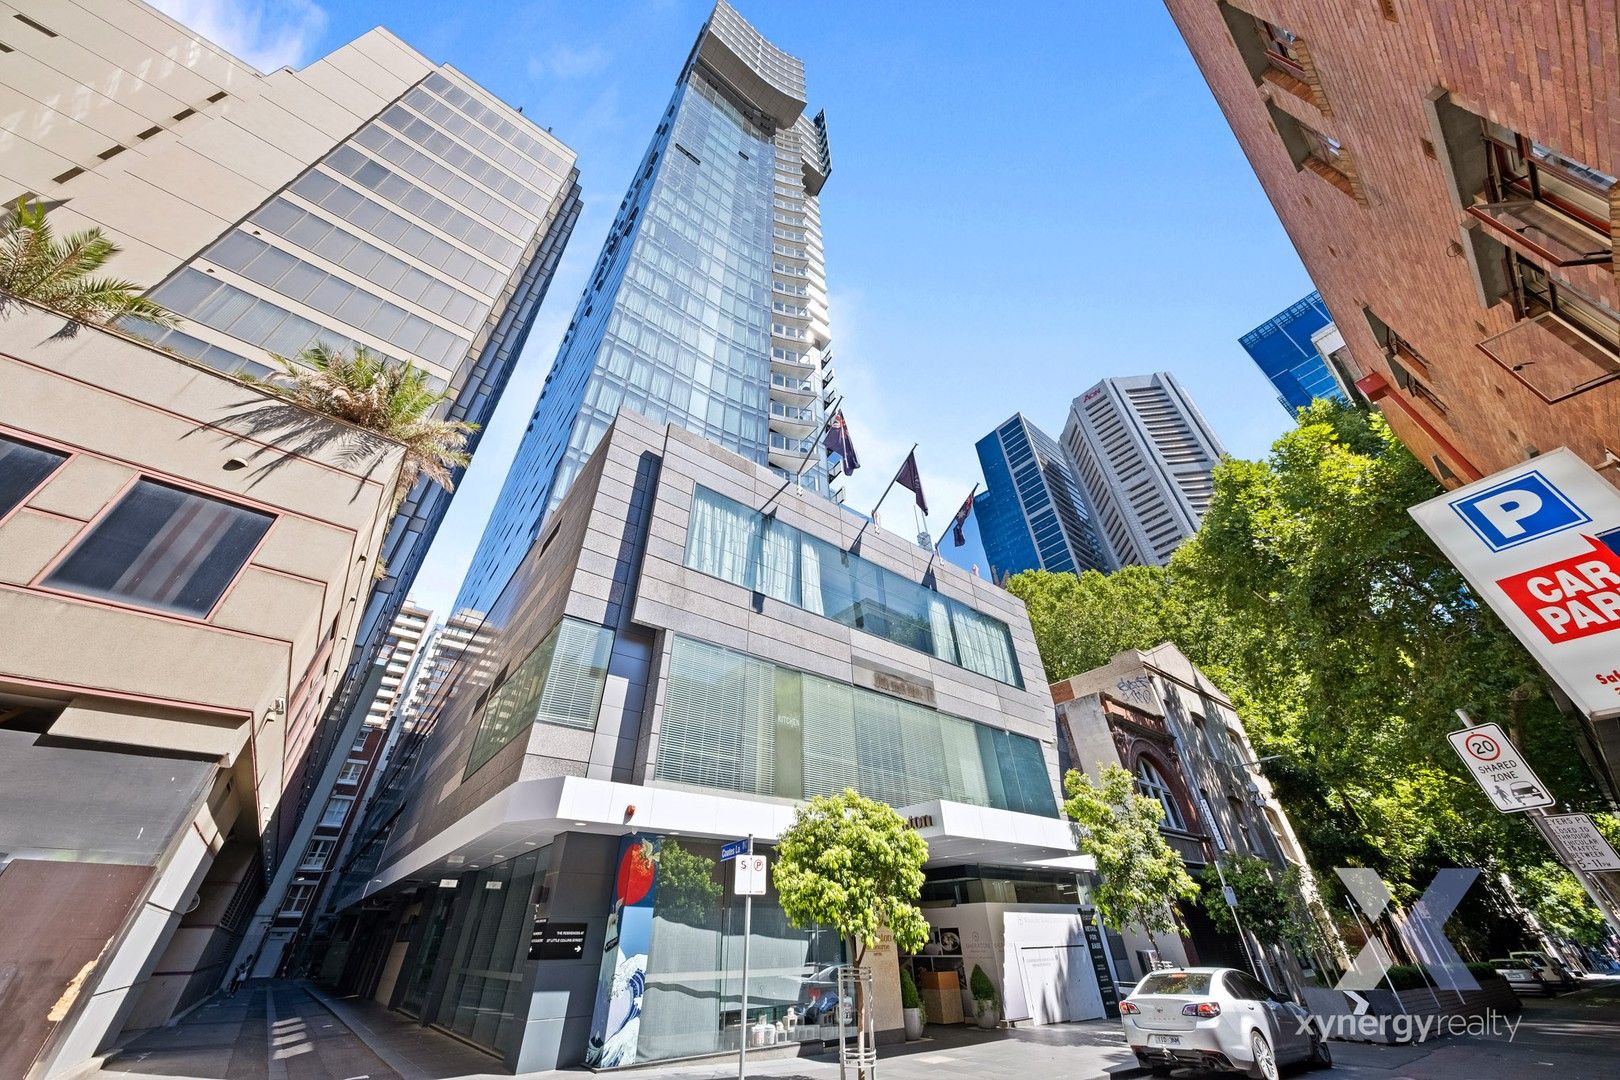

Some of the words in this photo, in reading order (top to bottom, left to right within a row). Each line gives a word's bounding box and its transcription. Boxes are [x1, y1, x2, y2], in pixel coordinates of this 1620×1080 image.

[1473, 489, 1543, 539] P
[1527, 560, 1620, 603] CAR
[1537, 588, 1620, 635] PAR
[1472, 740, 1495, 755] 20
[1478, 759, 1518, 775] SHARED
[1490, 771, 1519, 783] ZONE
[903, 814, 934, 831] ton
[1562, 839, 1599, 847] EHICULAR
[1571, 851, 1605, 859] BETWEEN
